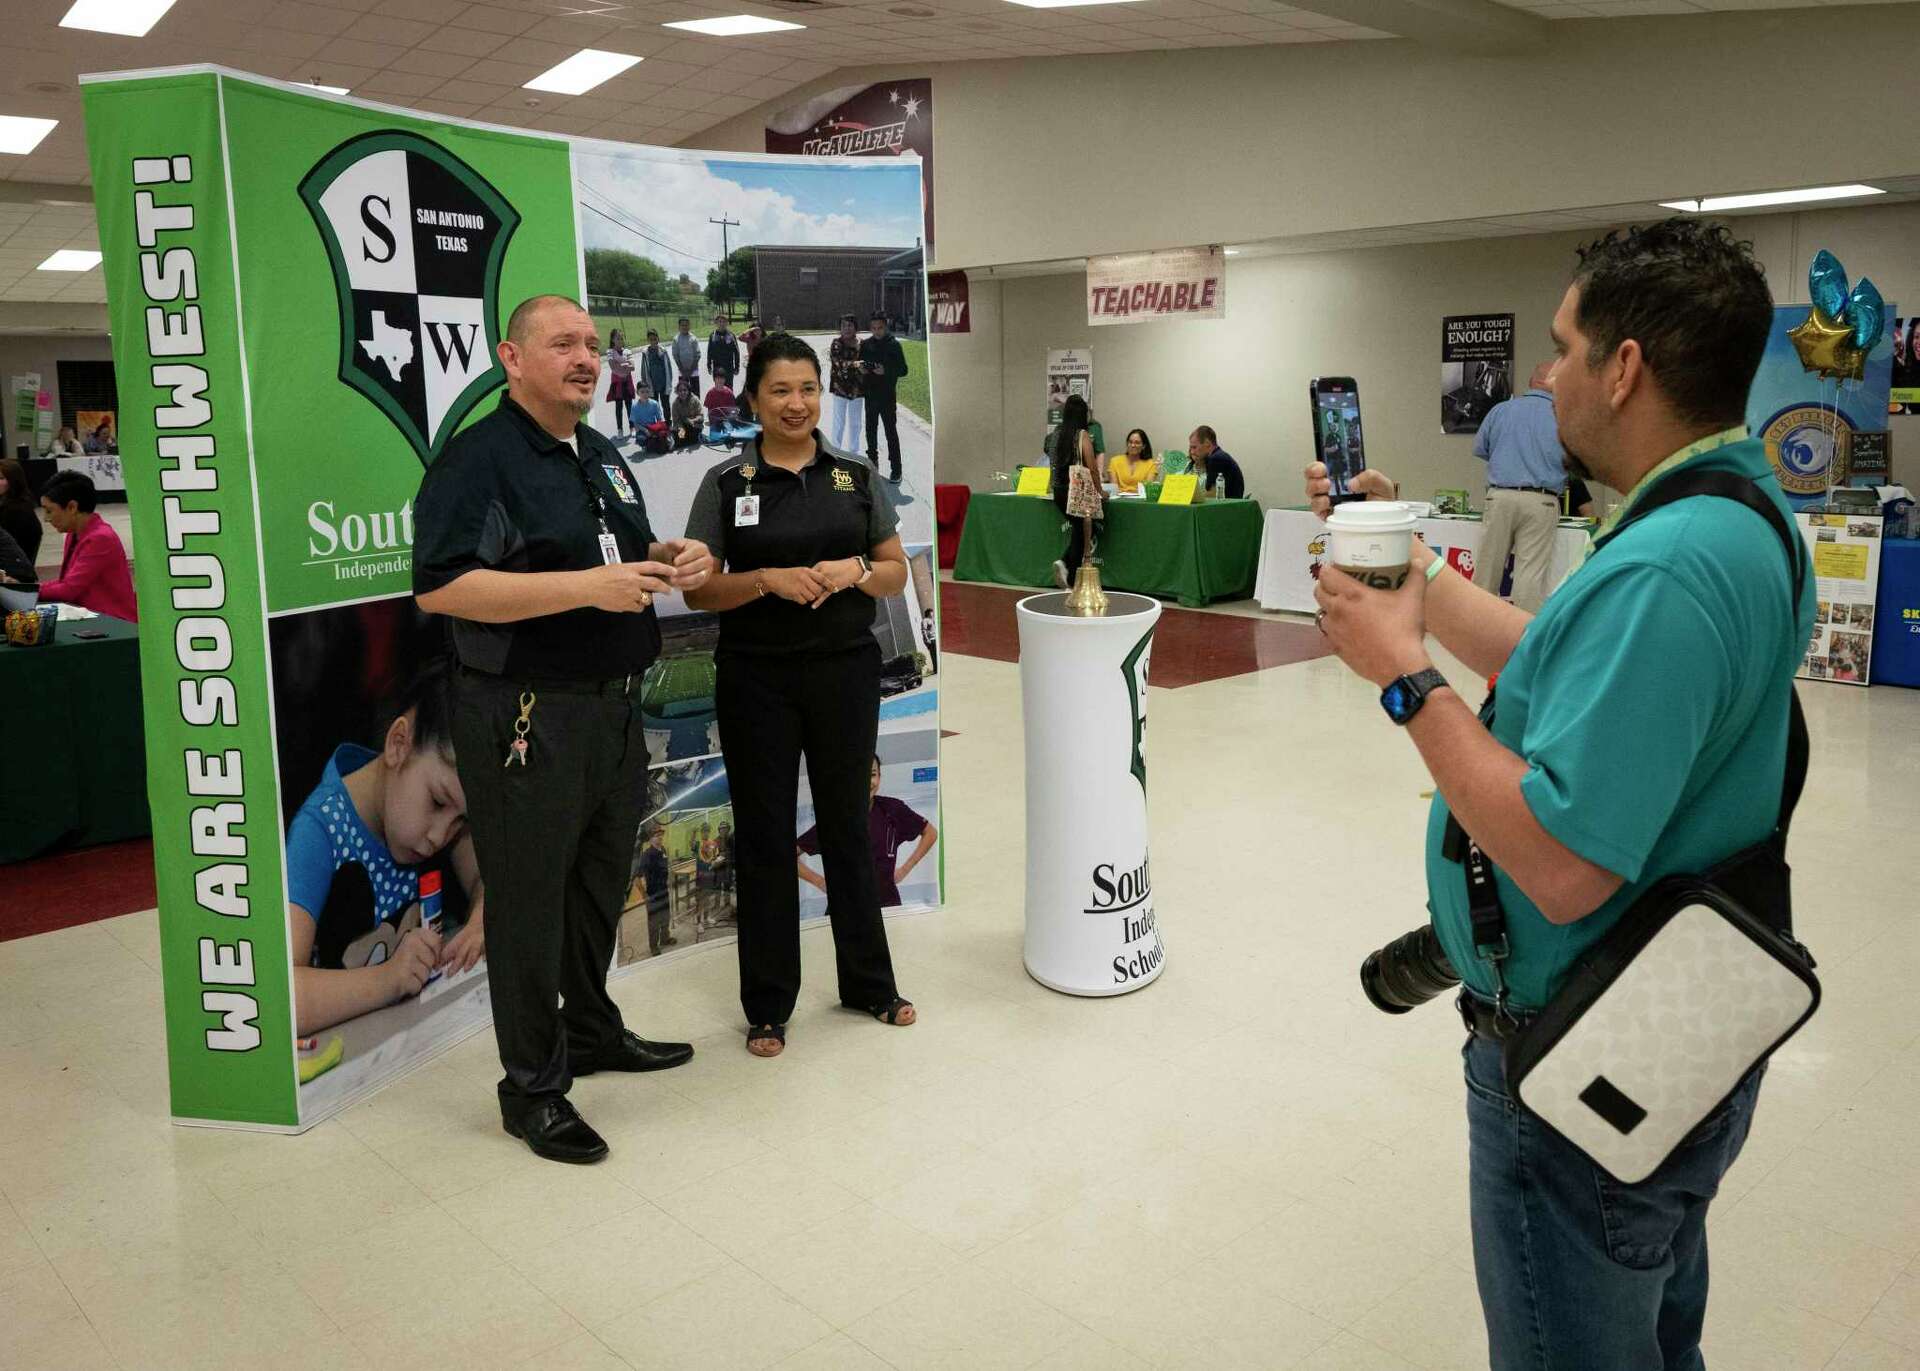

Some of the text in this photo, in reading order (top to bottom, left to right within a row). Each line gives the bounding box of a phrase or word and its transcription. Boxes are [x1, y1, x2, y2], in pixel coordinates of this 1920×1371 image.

[360, 194, 397, 263] S
[416, 208, 485, 230] SAN ANTONIO
[435, 235, 469, 253] TEXAS
[1091, 278, 1218, 316] TEACHABLE
[936, 301, 966, 326] WAY
[1447, 319, 1511, 330] ARE YOU TOUGH
[422, 322, 480, 374] W
[1447, 329, 1511, 344] ENOUGH?
[334, 556, 414, 580] Independe
[132, 154, 262, 1052] WE ARE SOUTHWEST!
[1111, 936, 1164, 984] School
